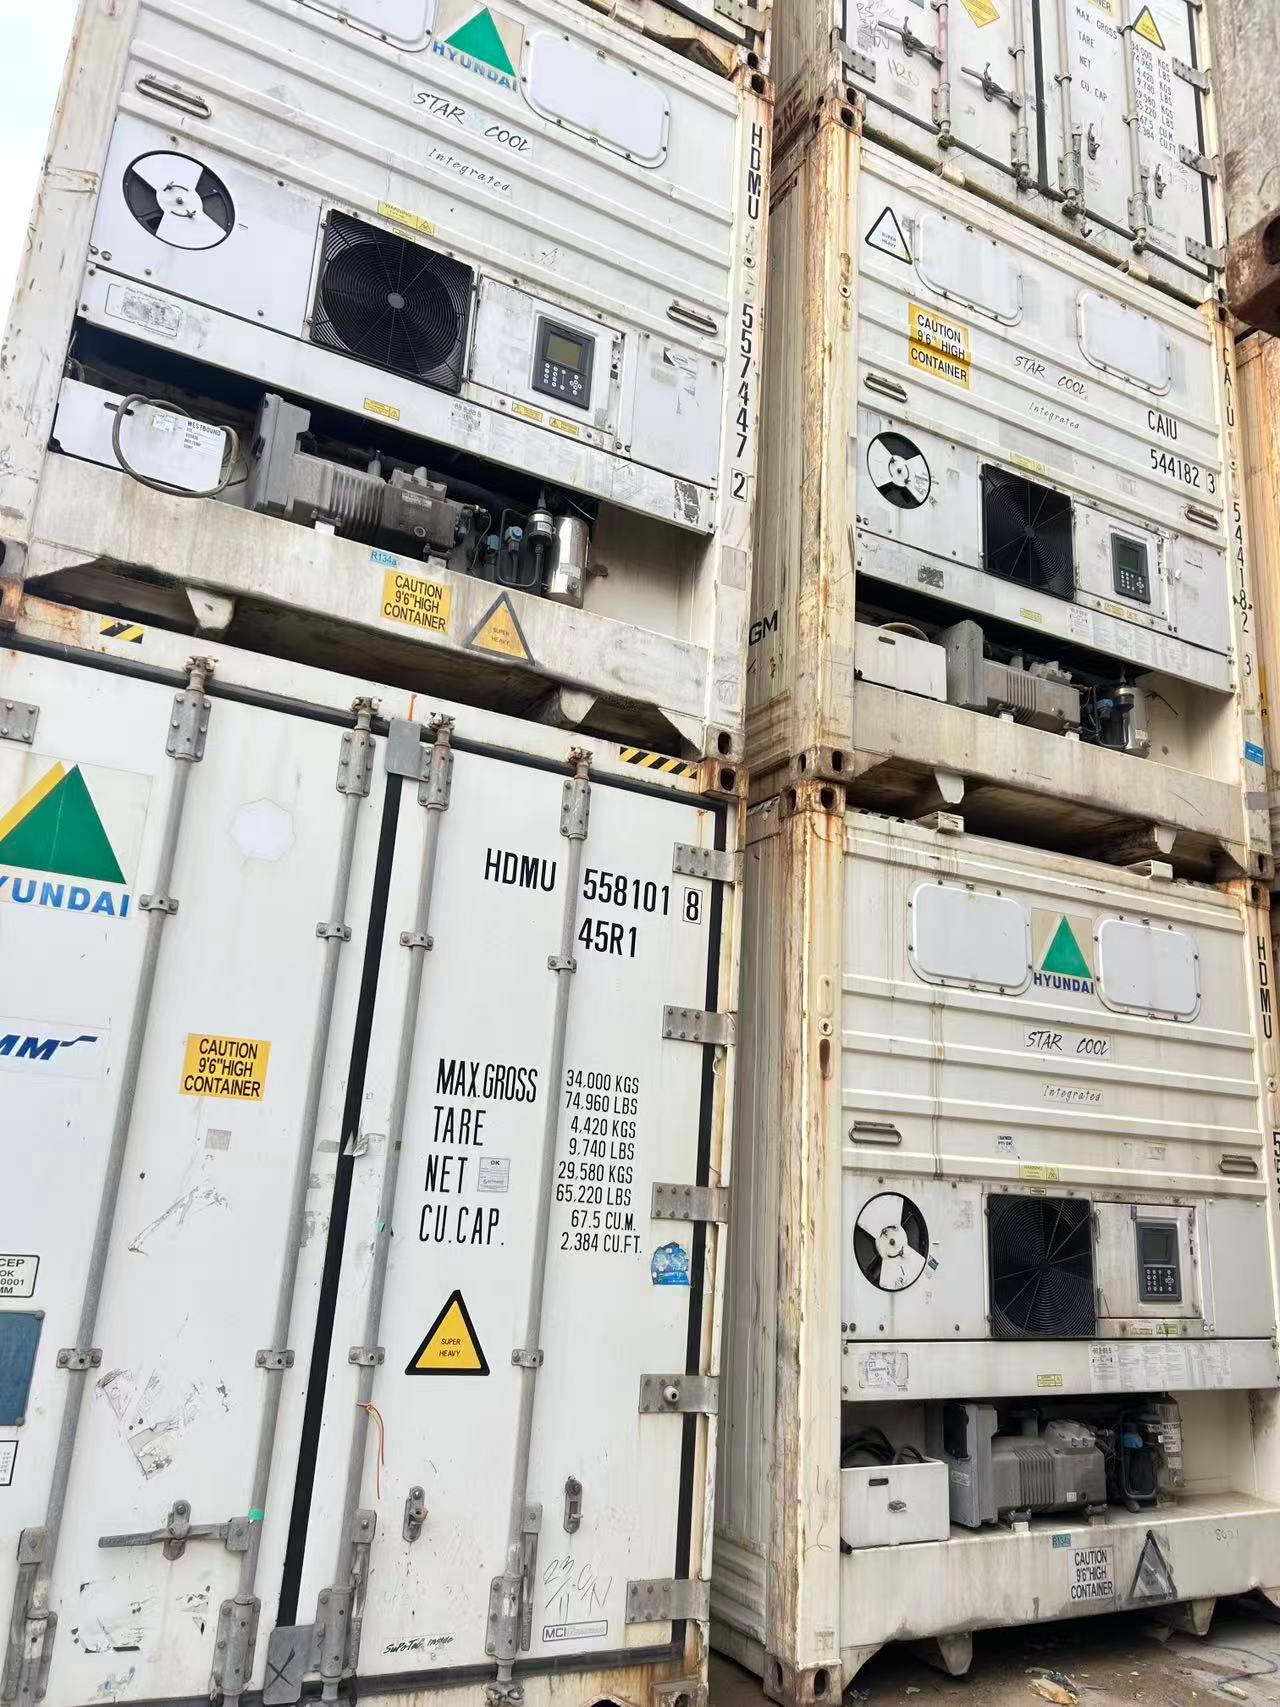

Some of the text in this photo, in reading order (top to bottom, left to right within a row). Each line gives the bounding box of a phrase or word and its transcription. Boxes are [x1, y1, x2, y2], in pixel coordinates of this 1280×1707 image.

[1078, 31, 1095, 48] TARE
[1096, 20, 1118, 40] GROSS
[433, 41, 517, 91] HYUNDAI
[1080, 55, 1092, 70] NET
[1158, 58, 1171, 73] KGS
[1158, 69, 1171, 84] LBS
[1160, 82, 1172, 97] KGS
[1160, 92, 1173, 107] LBS
[413, 92, 532, 151] STAR COOL
[1161, 105, 1174, 120] KGS
[1161, 116, 1175, 130] LBS
[428, 148, 513, 191] Integrated
[748, 122, 763, 220] HDMU
[917, 314, 961, 344] CAUTION
[941, 341, 965, 361] HIGH
[910, 347, 967, 383] CONTAINER
[1014, 356, 1087, 396] STAR COOL
[733, 303, 754, 499] 557447 2
[1029, 402, 1080, 430] Integrated
[1148, 410, 1178, 440] CAIU
[187, 420, 221, 437] WESTBOUND
[1150, 448, 1216, 494] 544182 3
[371, 551, 397, 566] R134a
[395, 575, 443, 600] CAUTION
[384, 602, 446, 631] CONTAINER
[492, 627, 510, 637] SUPER
[1243, 655, 1253, 677] 3
[484, 848, 557, 892] HDMU
[583, 868, 699, 921] 558101 8
[578, 918, 637, 958] 45R1
[1033, 972, 1094, 995] HYUNDAI
[1257, 936, 1272, 1039] HDMU
[199, 1038, 258, 1059] CAUTION
[1026, 1031, 1108, 1055] STAR COOL
[184, 1075, 261, 1097] CONTAINER
[615, 1075, 640, 1094] KGS
[1044, 1085, 1101, 1103] Integrated
[614, 1096, 638, 1115] LBS
[434, 1105, 486, 1146] TARE
[612, 1119, 636, 1139] KGS
[611, 1141, 635, 1160] LBS
[425, 1154, 468, 1194] NET
[609, 1165, 633, 1184] KGS
[607, 1187, 631, 1206] LBS
[571, 1210, 601, 1229] 67.5
[441, 1338, 461, 1346] SUPER
[439, 1350, 461, 1358] HEAVY
[1074, 1550, 1107, 1567] CAUTION
[1071, 1581, 1113, 1600] CONTAINER
[545, 1627, 566, 1639] MCI
